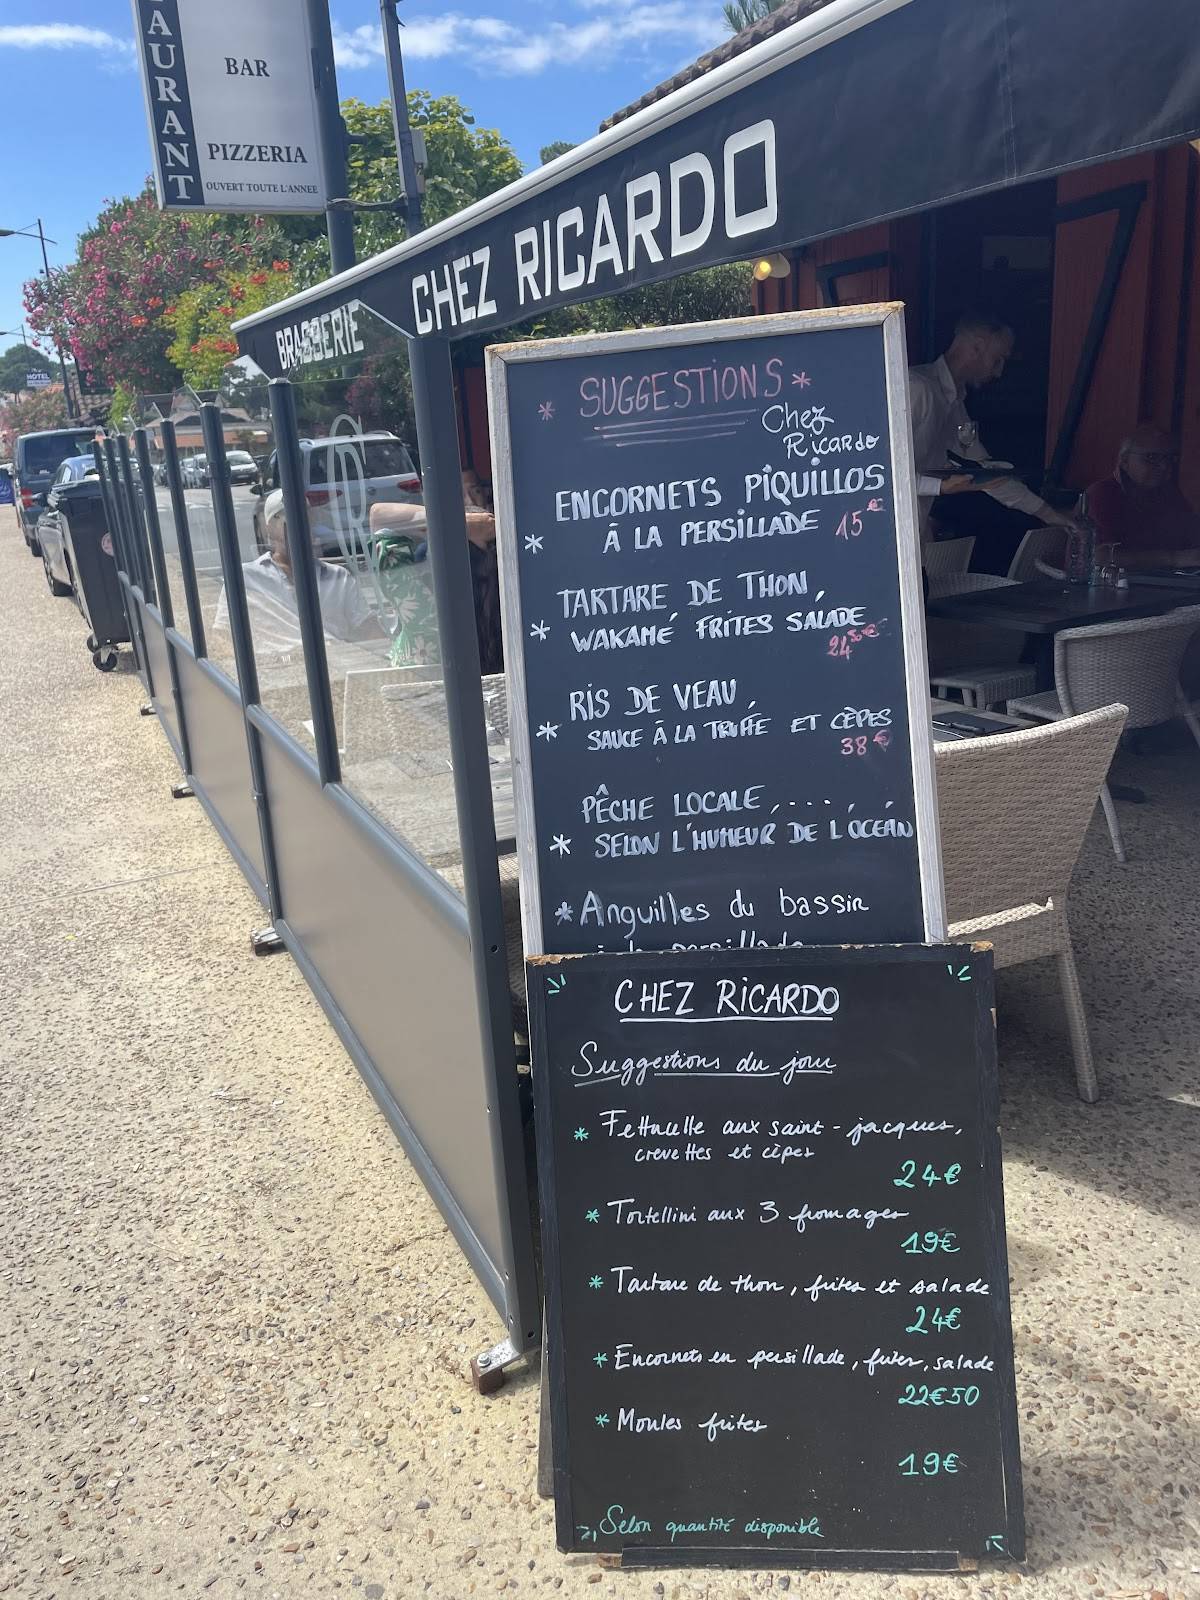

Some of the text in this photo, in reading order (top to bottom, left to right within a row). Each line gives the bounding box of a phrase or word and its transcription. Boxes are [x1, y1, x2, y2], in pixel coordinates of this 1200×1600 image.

[225, 58, 270, 77] BAR
[147, 0, 194, 200] AURANT
[208, 144, 307, 163] PIZZERIA
[206, 182, 318, 193] OUVERT TOUTE L'ANNEE
[276, 119, 777, 370] BRASSERIE CHEZ RICARDO
[580, 359, 784, 418] SUGGESTIONS
[762, 402, 834, 438] Chez
[556, 456, 884, 524] ENCORNETS PIQUILLOS
[635, 526, 662, 549] LA
[681, 509, 820, 546] PERSILLADE
[557, 584, 668, 618] TARTARE
[687, 579, 722, 605] DE
[696, 610, 773, 639] FRITES
[786, 607, 867, 630] SALADE
[570, 684, 610, 720] RIS
[624, 685, 660, 715] DE
[588, 729, 643, 750] SAUCE
[675, 725, 695, 743] LA
[791, 715, 821, 732] ET
[581, 784, 654, 823] PÊCHE
[595, 832, 659, 857] SELON
[673, 823, 776, 852] L'HUMEUR
[787, 822, 817, 843] DE
[580, 888, 869, 938] Anguilles du bassin
[615, 977, 839, 1015] CHEZ RICARDO
[571, 1041, 722, 1087] Suggestions
[736, 1052, 769, 1072] du
[723, 1120, 760, 1134] aux
[635, 1143, 711, 1161] crevettes
[728, 1144, 752, 1159] et
[894, 1160, 961, 1188] 24€
[607, 1199, 909, 1233] Tortellini aux 3 fromages
[901, 1232, 960, 1253] 19€
[611, 1266, 688, 1293] Tartare
[698, 1276, 722, 1291] de
[804, 1275, 866, 1302] frites
[875, 1279, 900, 1294] et
[909, 1278, 989, 1294] salade
[906, 1306, 961, 1333] 24€
[615, 1344, 702, 1369] Encornets
[708, 1352, 736, 1363] en
[933, 1355, 994, 1371] salade
[898, 1385, 979, 1406] 22€50
[618, 1408, 767, 1441] Moules frites
[899, 1453, 959, 1475] 19€
[600, 1505, 824, 1542] Selon quantité disponible
